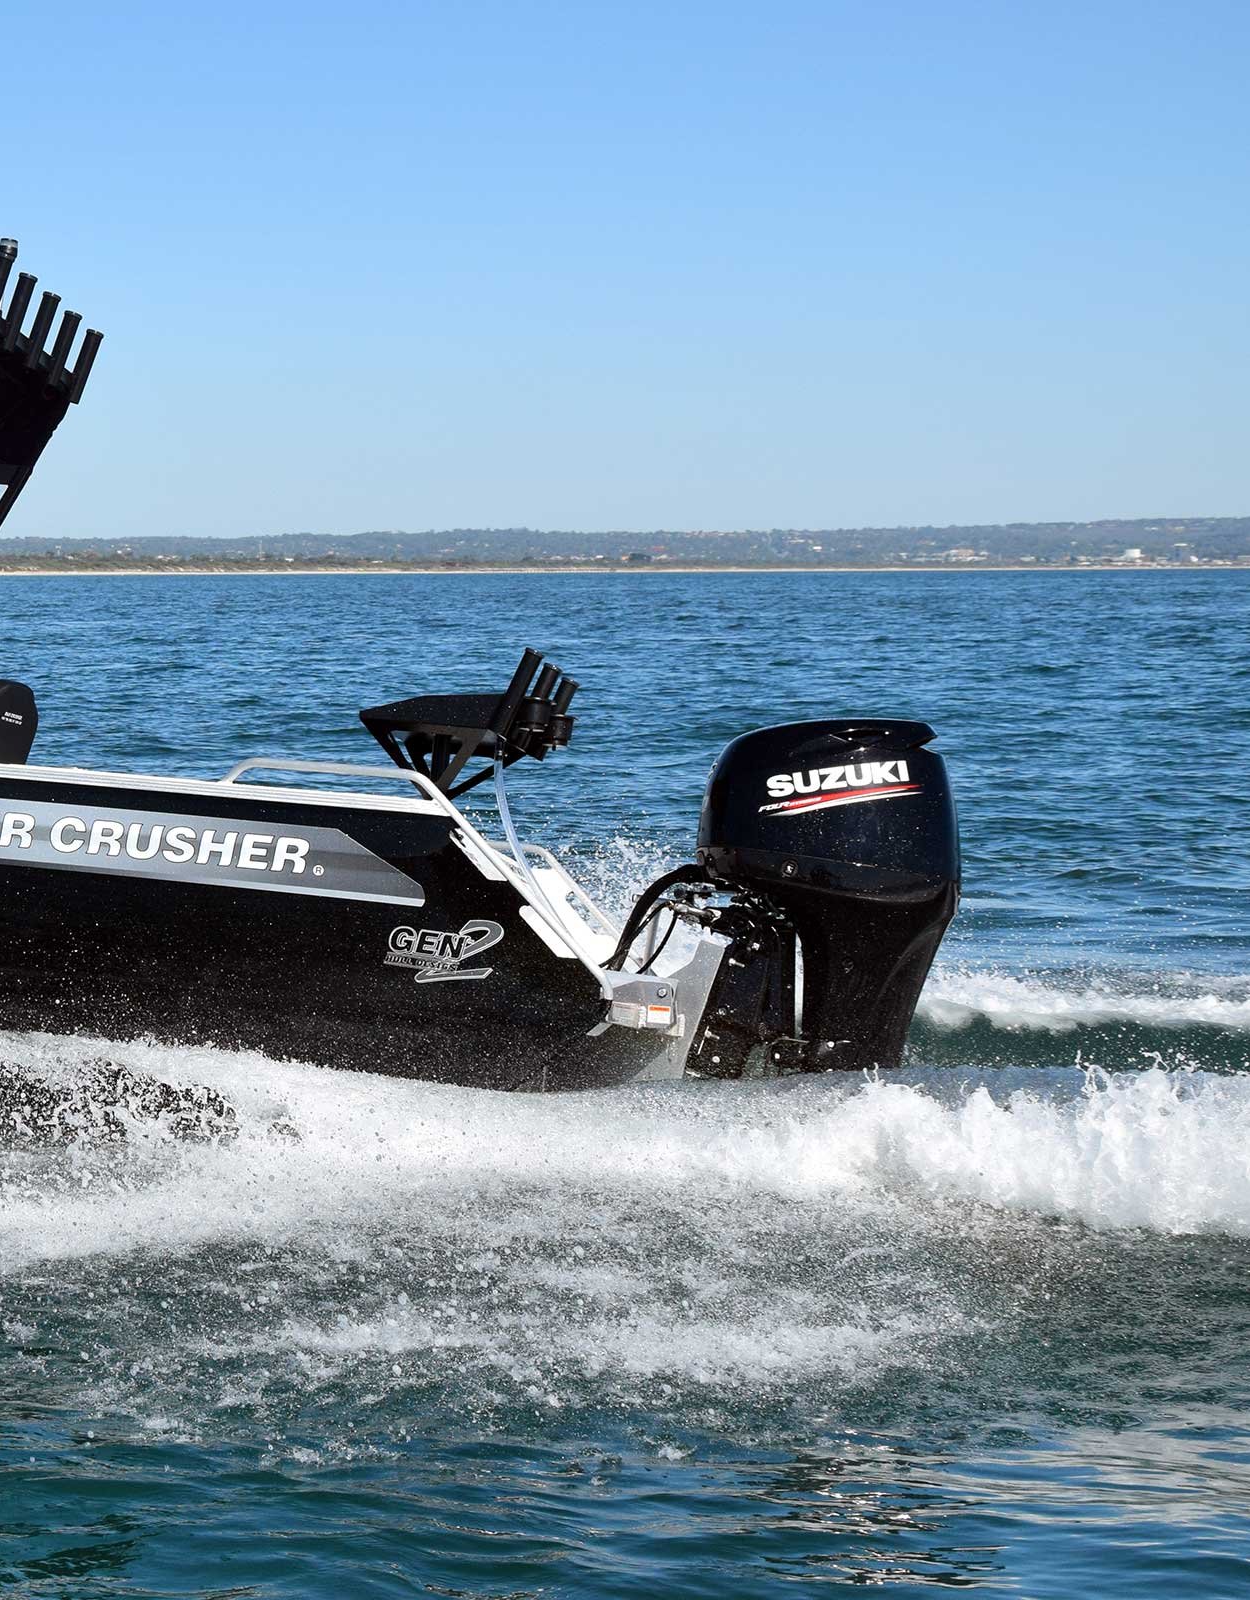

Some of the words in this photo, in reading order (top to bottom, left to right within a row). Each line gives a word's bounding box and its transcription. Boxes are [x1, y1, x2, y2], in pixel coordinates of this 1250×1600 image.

[766, 760, 910, 798] SUZUKI
[50, 815, 311, 874] CRUSHER
[388, 925, 467, 962] GEN
